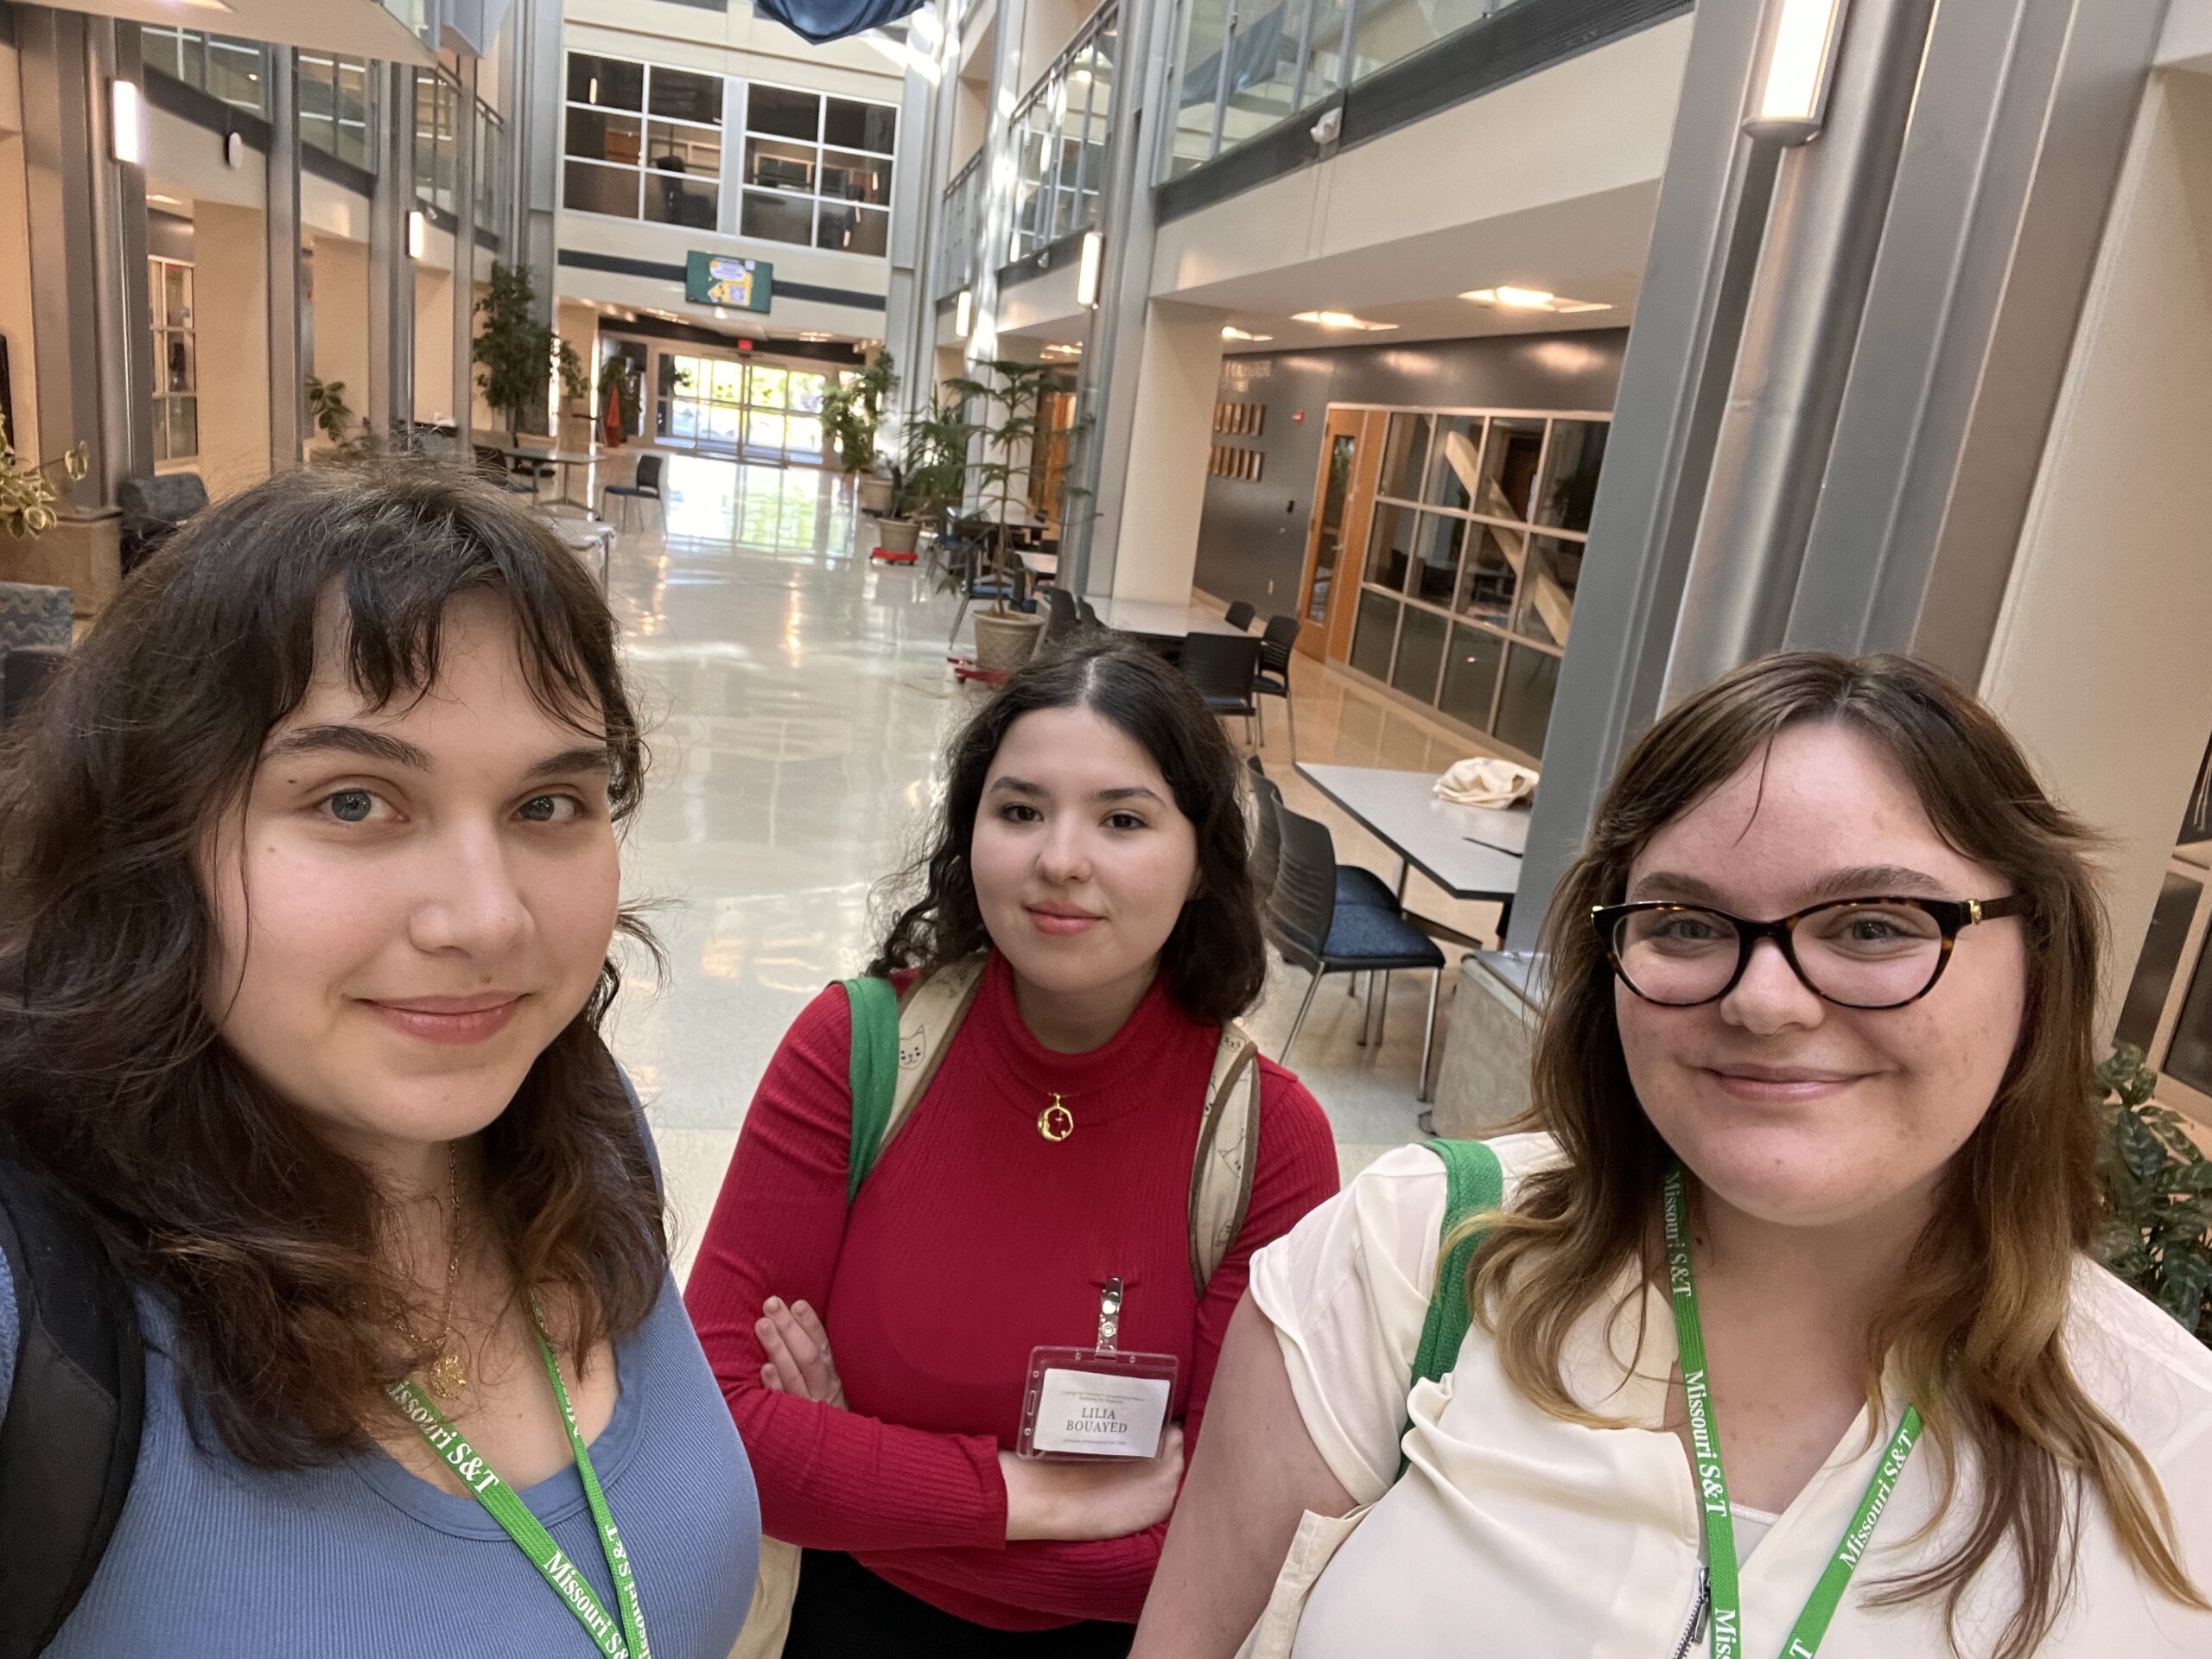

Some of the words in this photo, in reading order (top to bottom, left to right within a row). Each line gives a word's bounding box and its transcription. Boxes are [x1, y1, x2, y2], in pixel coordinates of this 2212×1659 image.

[1664, 1171, 1685, 1248] Missouri
[1669, 1253, 1691, 1296] S&T
[1066, 1420, 1128, 1433] BOUAYED
[1082, 1407, 1116, 1420] LILIA
[1686, 1370, 1717, 1459] Missouri
[446, 1443, 499, 1493] S&T
[1700, 1464, 1727, 1517] S&T
[1840, 1478, 1891, 1570] Missouri
[1884, 1429, 1912, 1482] S&T
[605, 1524, 632, 1577] S&T
[543, 1550, 612, 1638] Missouri
